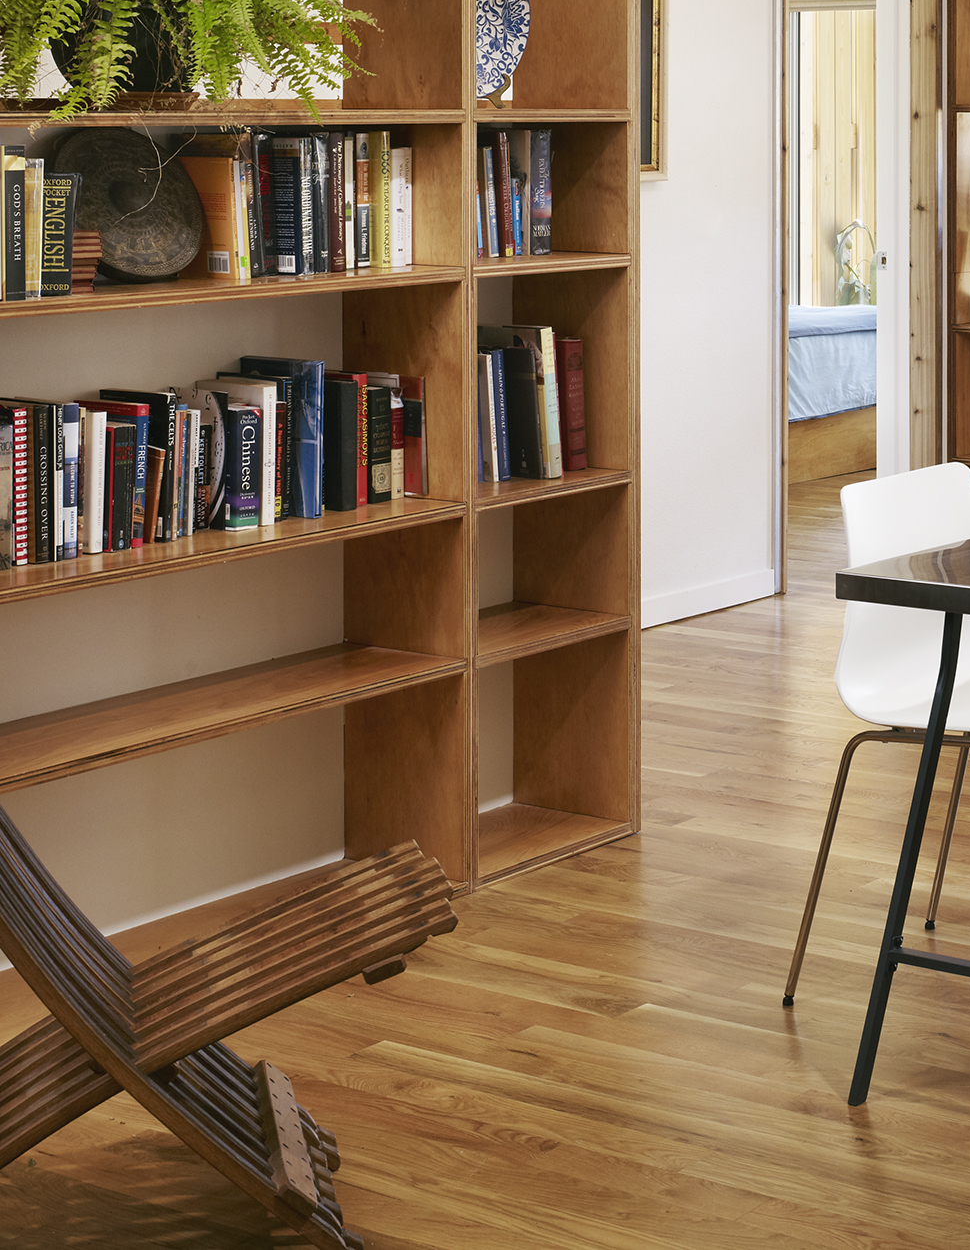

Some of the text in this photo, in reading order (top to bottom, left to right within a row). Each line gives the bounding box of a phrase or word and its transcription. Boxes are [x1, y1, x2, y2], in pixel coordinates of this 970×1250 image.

[247, 164, 255, 206] UNBROKEN
[259, 154, 271, 197] HOMICIDE
[382, 150, 390, 175] 1066
[13, 184, 22, 262] GOD'S BREATH
[44, 198, 66, 268] ENGLISH
[301, 176, 314, 256] NO ORDINARY TIME
[384, 204, 389, 212] OF
[137, 444, 146, 480] FRENCH
[241, 426, 256, 491] Chinese
[40, 446, 48, 540] CROSSING OVER
